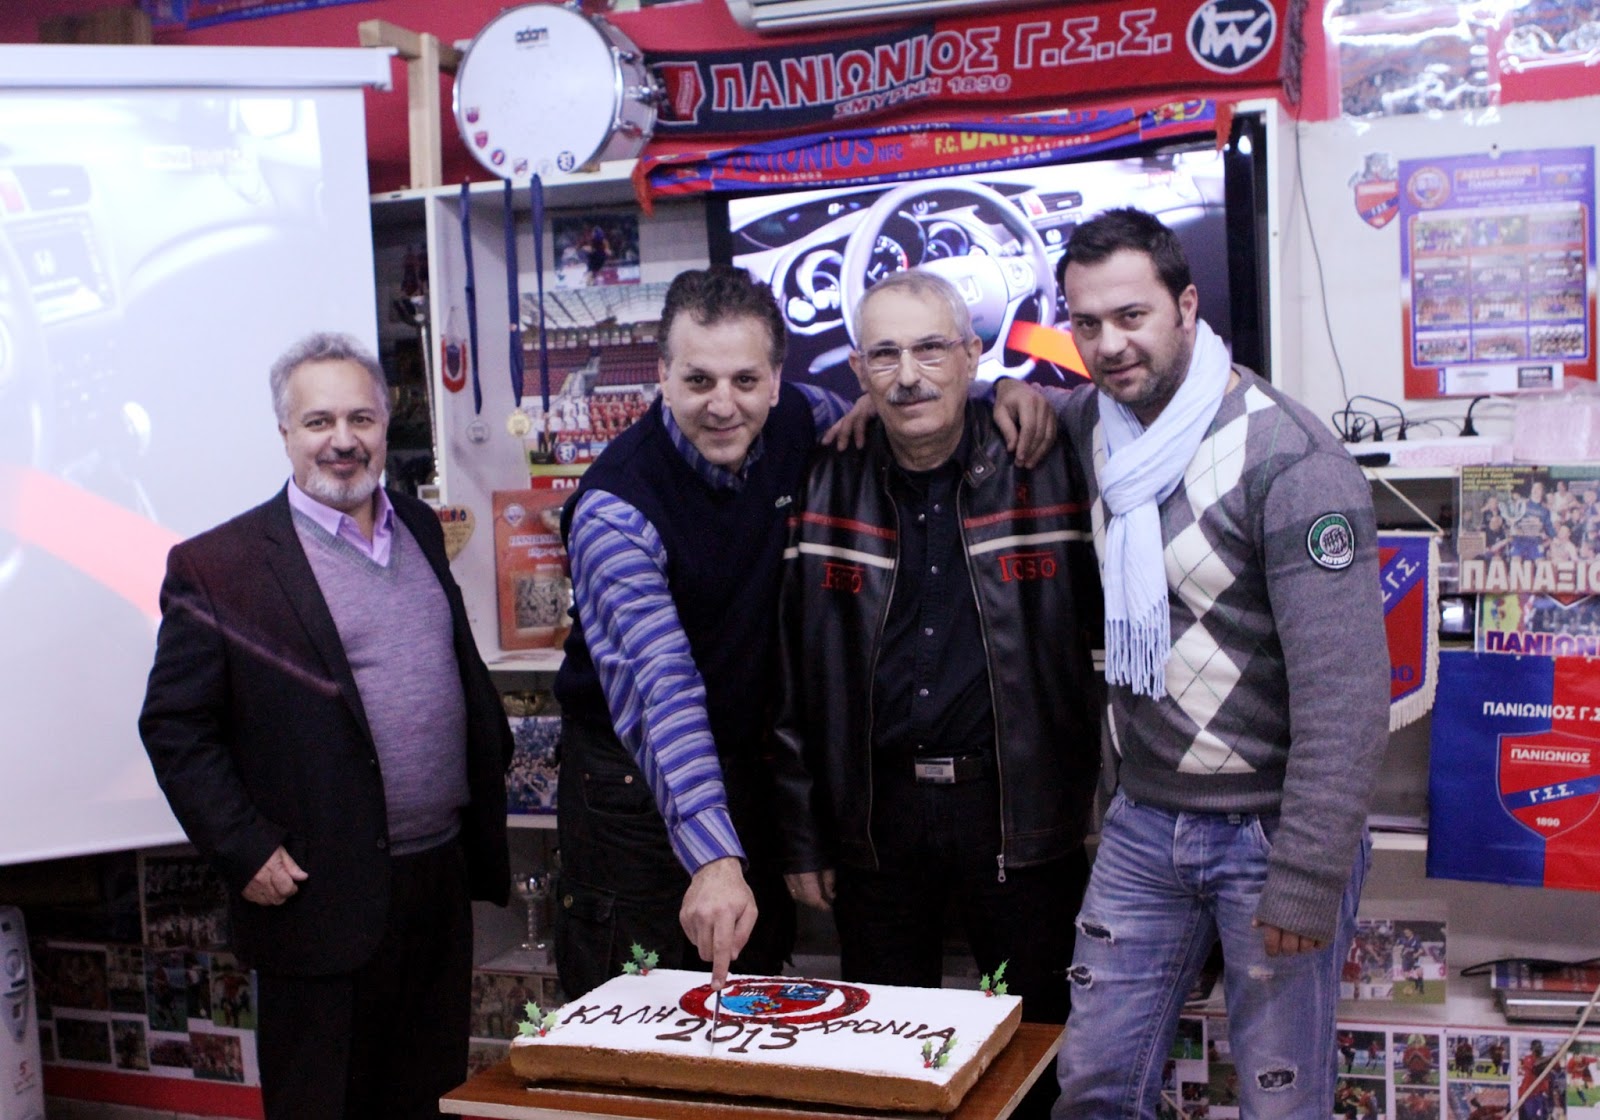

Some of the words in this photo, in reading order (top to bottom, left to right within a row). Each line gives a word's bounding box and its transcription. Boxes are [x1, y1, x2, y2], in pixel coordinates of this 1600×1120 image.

[711, 26, 1001, 112] ΠΑΝΙΩΝΙΟΣ
[1013, 8, 1173, 69] Γ.Σ.Σ.
[947, 74, 1011, 94] 1890
[934, 135, 959, 155] F.C.
[1485, 630, 1600, 657] ΠΑΝΙΩΝ
[1483, 701, 1576, 720] ΠΑΝΙΩΝΙΟΣ
[1510, 748, 1590, 764] ΠΑΝΙΩΝΙΟΣ
[1529, 784, 1574, 803] Γ.Σ.Σ.
[1535, 817, 1561, 828] 1890
[561, 1004, 678, 1025] ΚΑΛΗ
[799, 1018, 957, 1047] ΧΡΟΝΙΑ
[655, 1016, 800, 1053] 2013
